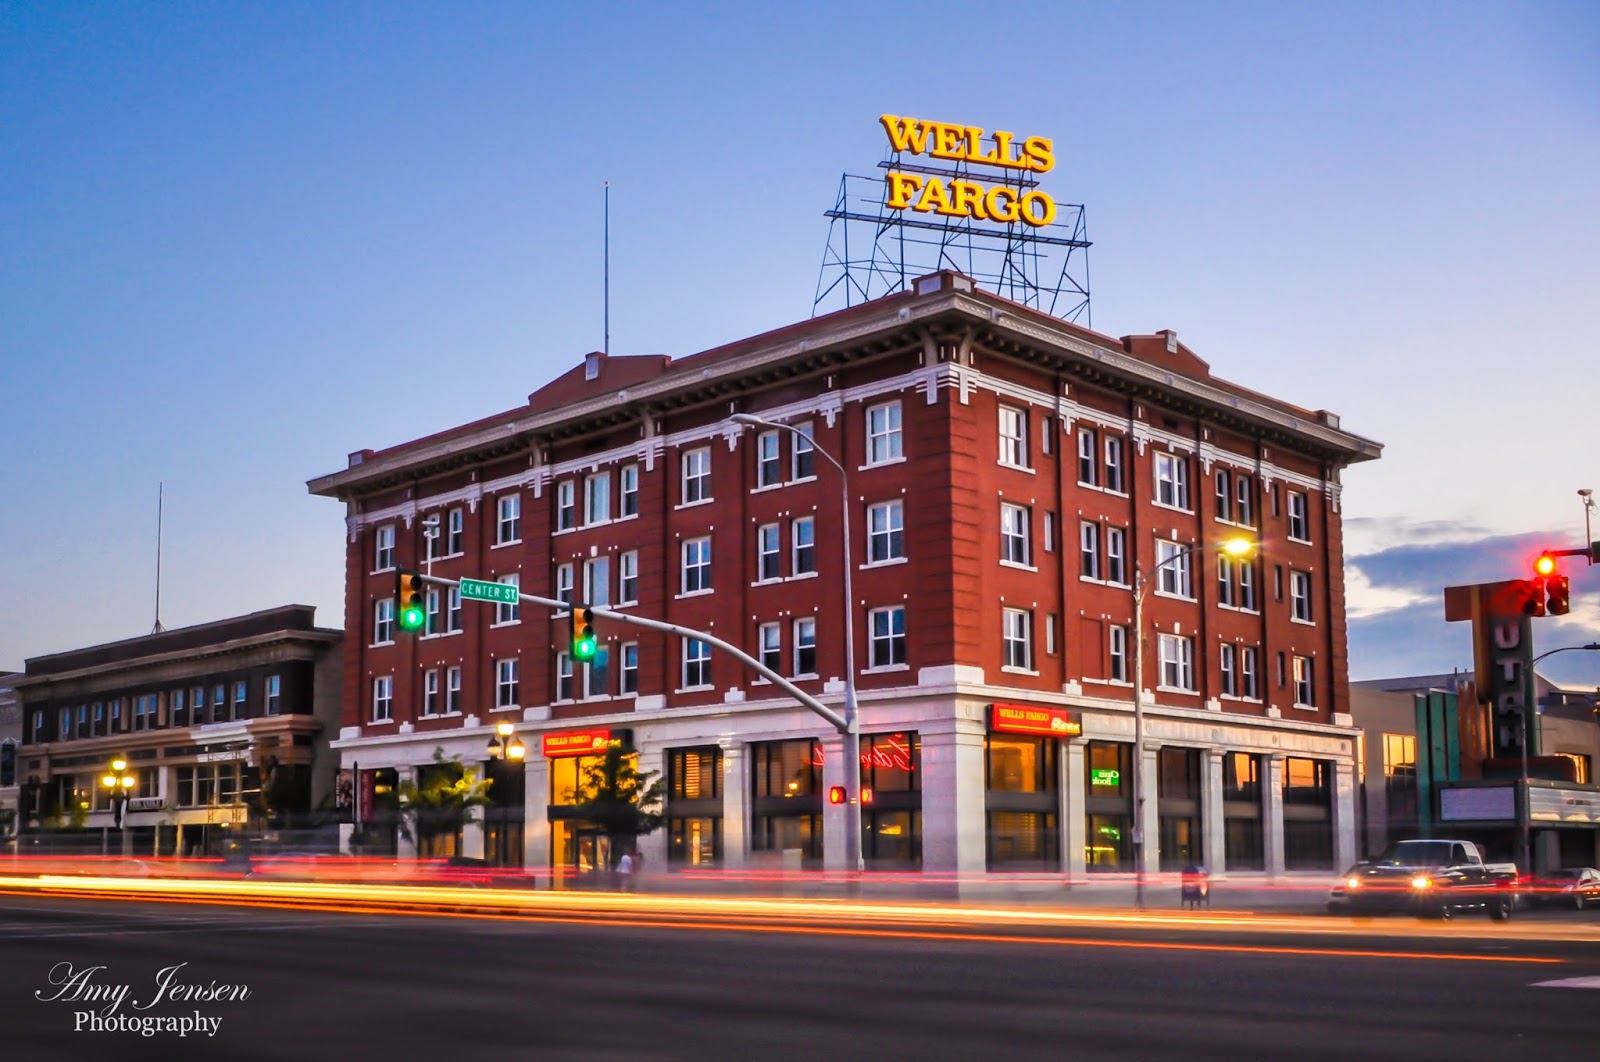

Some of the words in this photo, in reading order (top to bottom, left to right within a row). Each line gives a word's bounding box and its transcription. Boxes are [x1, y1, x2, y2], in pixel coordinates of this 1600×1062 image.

[879, 114, 1056, 173] WELLS
[885, 173, 1057, 228] FARGO
[462, 583, 500, 598] CENTER
[505, 588, 516, 600] ST
[999, 708, 1025, 719] WELLS
[1025, 711, 1049, 722] FARGO
[546, 737, 568, 746] WELLS
[568, 735, 591, 745] FARGO
